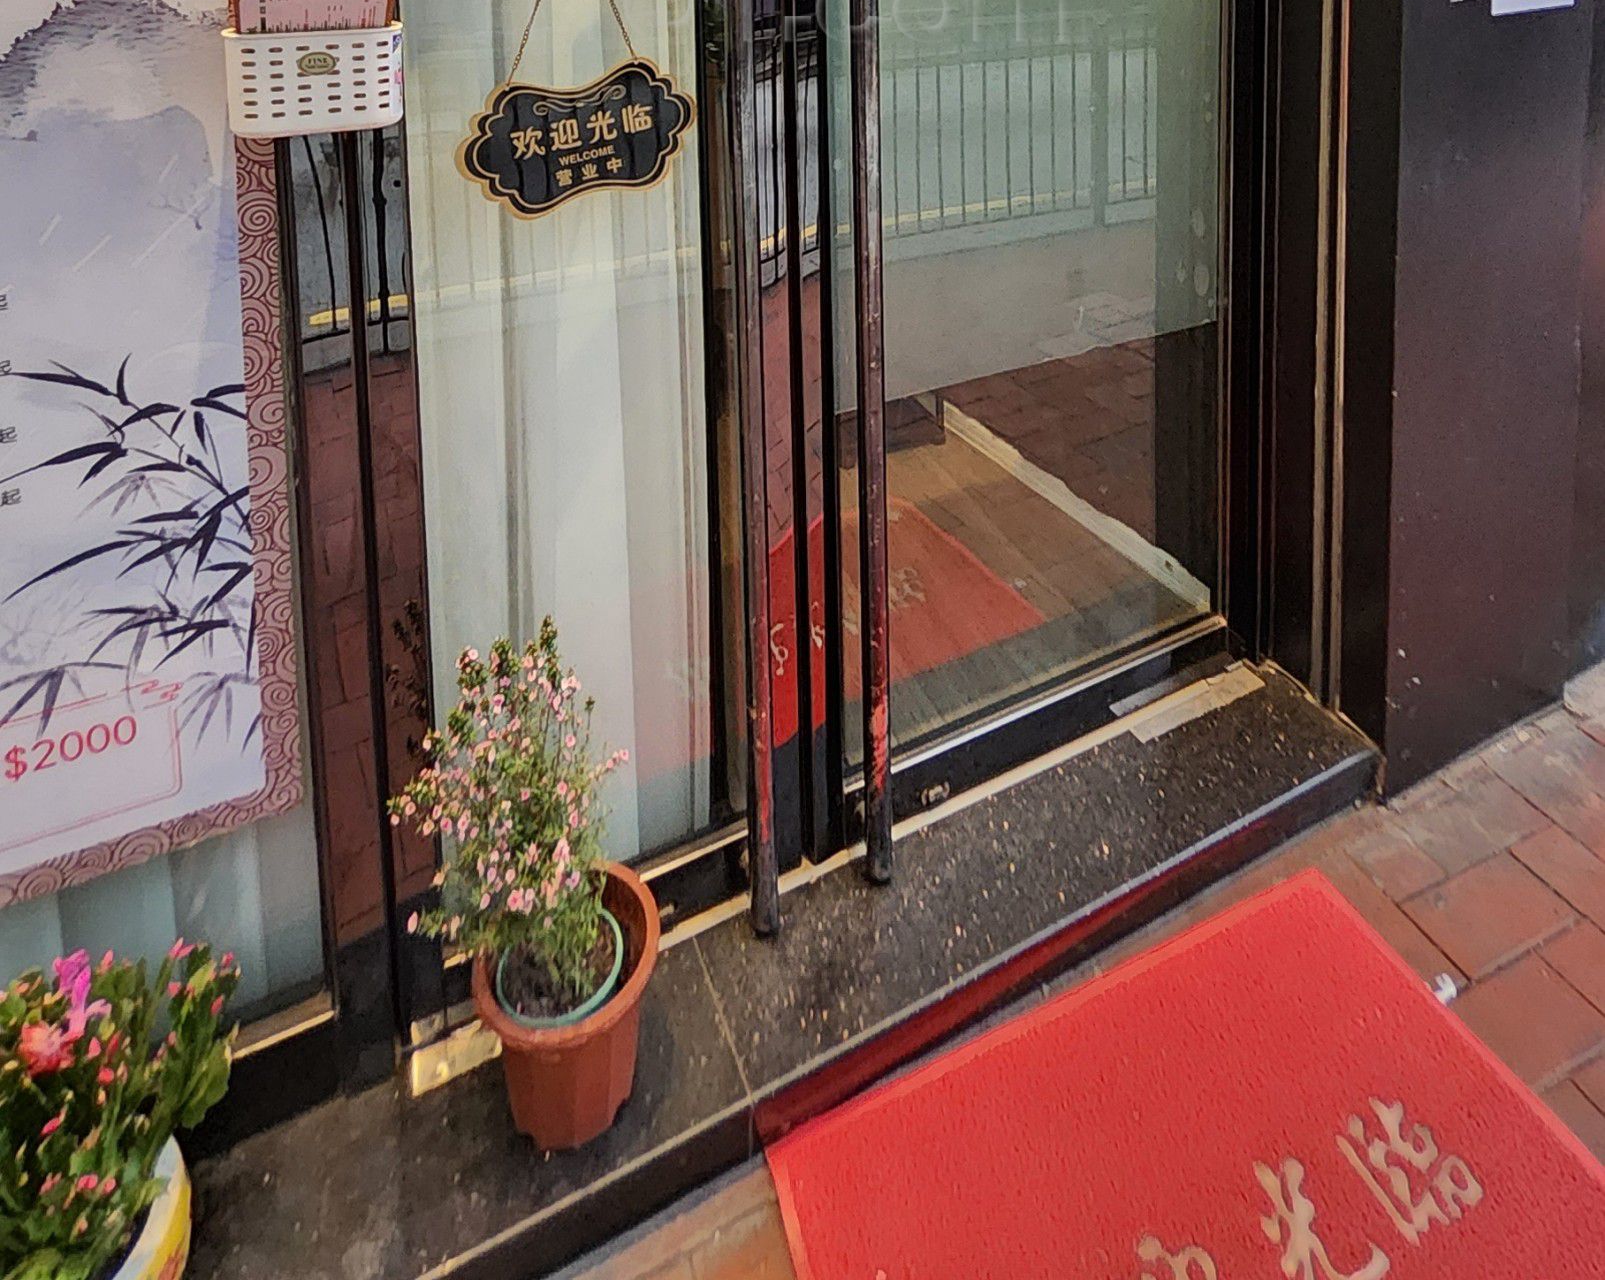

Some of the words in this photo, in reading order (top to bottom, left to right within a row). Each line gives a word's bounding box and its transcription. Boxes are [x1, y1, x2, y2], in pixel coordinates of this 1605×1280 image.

[510, 103, 654, 160] 欢迎光临
[555, 157, 623, 187] 营业中
[558, 145, 615, 167] WELCOME
[4, 715, 137, 781] $2000
